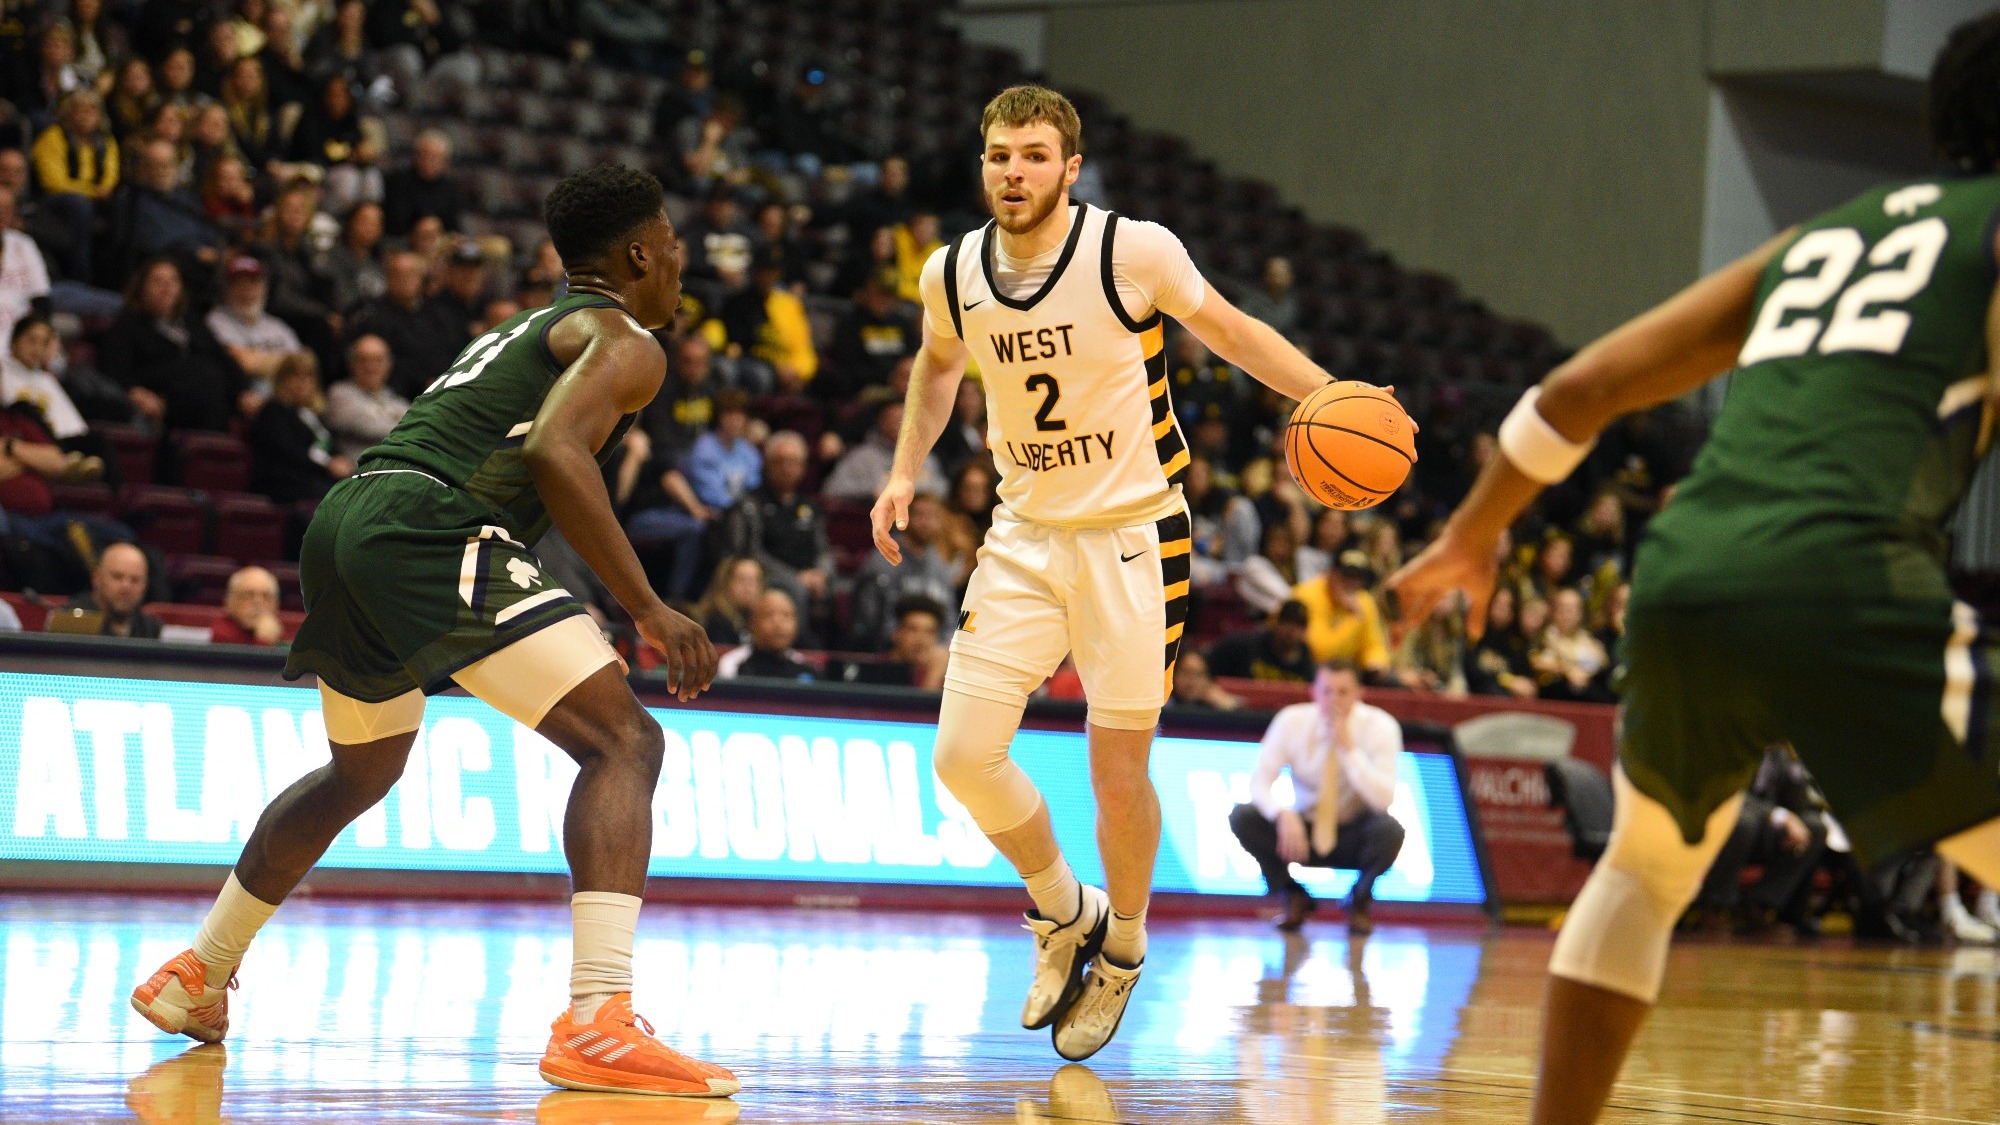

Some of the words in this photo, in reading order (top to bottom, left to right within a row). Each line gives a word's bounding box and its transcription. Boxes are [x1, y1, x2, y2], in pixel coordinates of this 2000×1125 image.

[1737, 216, 1949, 367] 22
[990, 324, 1074, 364] WEST
[1025, 373, 1068, 432] 2
[1007, 430, 1116, 472] LIBERTY
[14, 695, 496, 851] ATLANIC
[512, 722, 997, 868] RGIONALS
